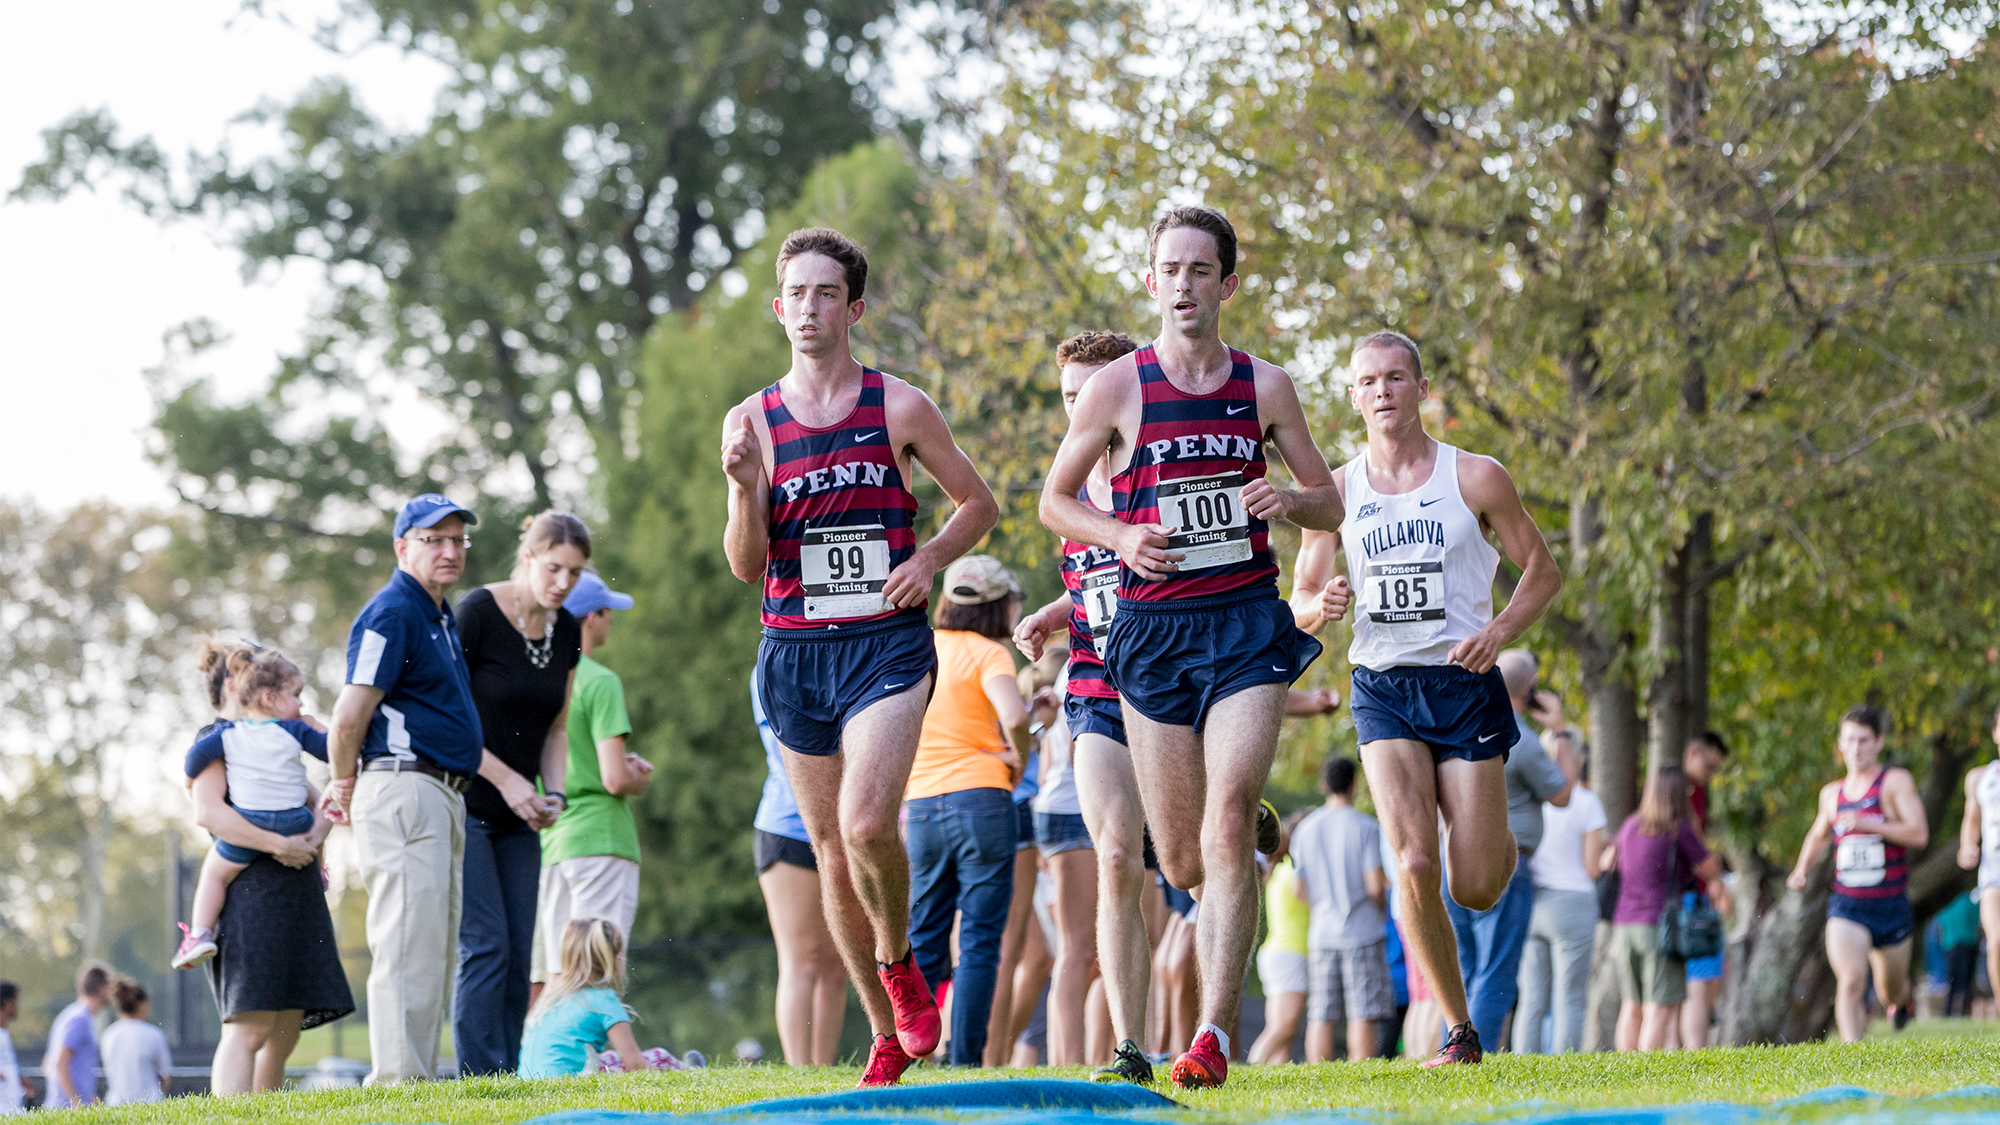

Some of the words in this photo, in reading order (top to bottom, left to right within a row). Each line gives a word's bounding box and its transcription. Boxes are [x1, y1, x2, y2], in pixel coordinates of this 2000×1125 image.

[1147, 434, 1257, 465] PENN
[781, 462, 888, 503] PENN
[1179, 479, 1222, 493] Pioneer
[1177, 492, 1233, 532] 100
[1357, 507, 1383, 518] EAST
[1359, 501, 1377, 511] BIG
[822, 532, 867, 543] Pioneer
[1187, 531, 1228, 544] Timing
[1362, 519, 1445, 559] VILLANOVA
[827, 546, 865, 580] 99
[1381, 566, 1421, 575] Pioneer
[827, 582, 869, 593] Timing
[1378, 577, 1428, 610] 185
[1384, 611, 1423, 621] Timing
